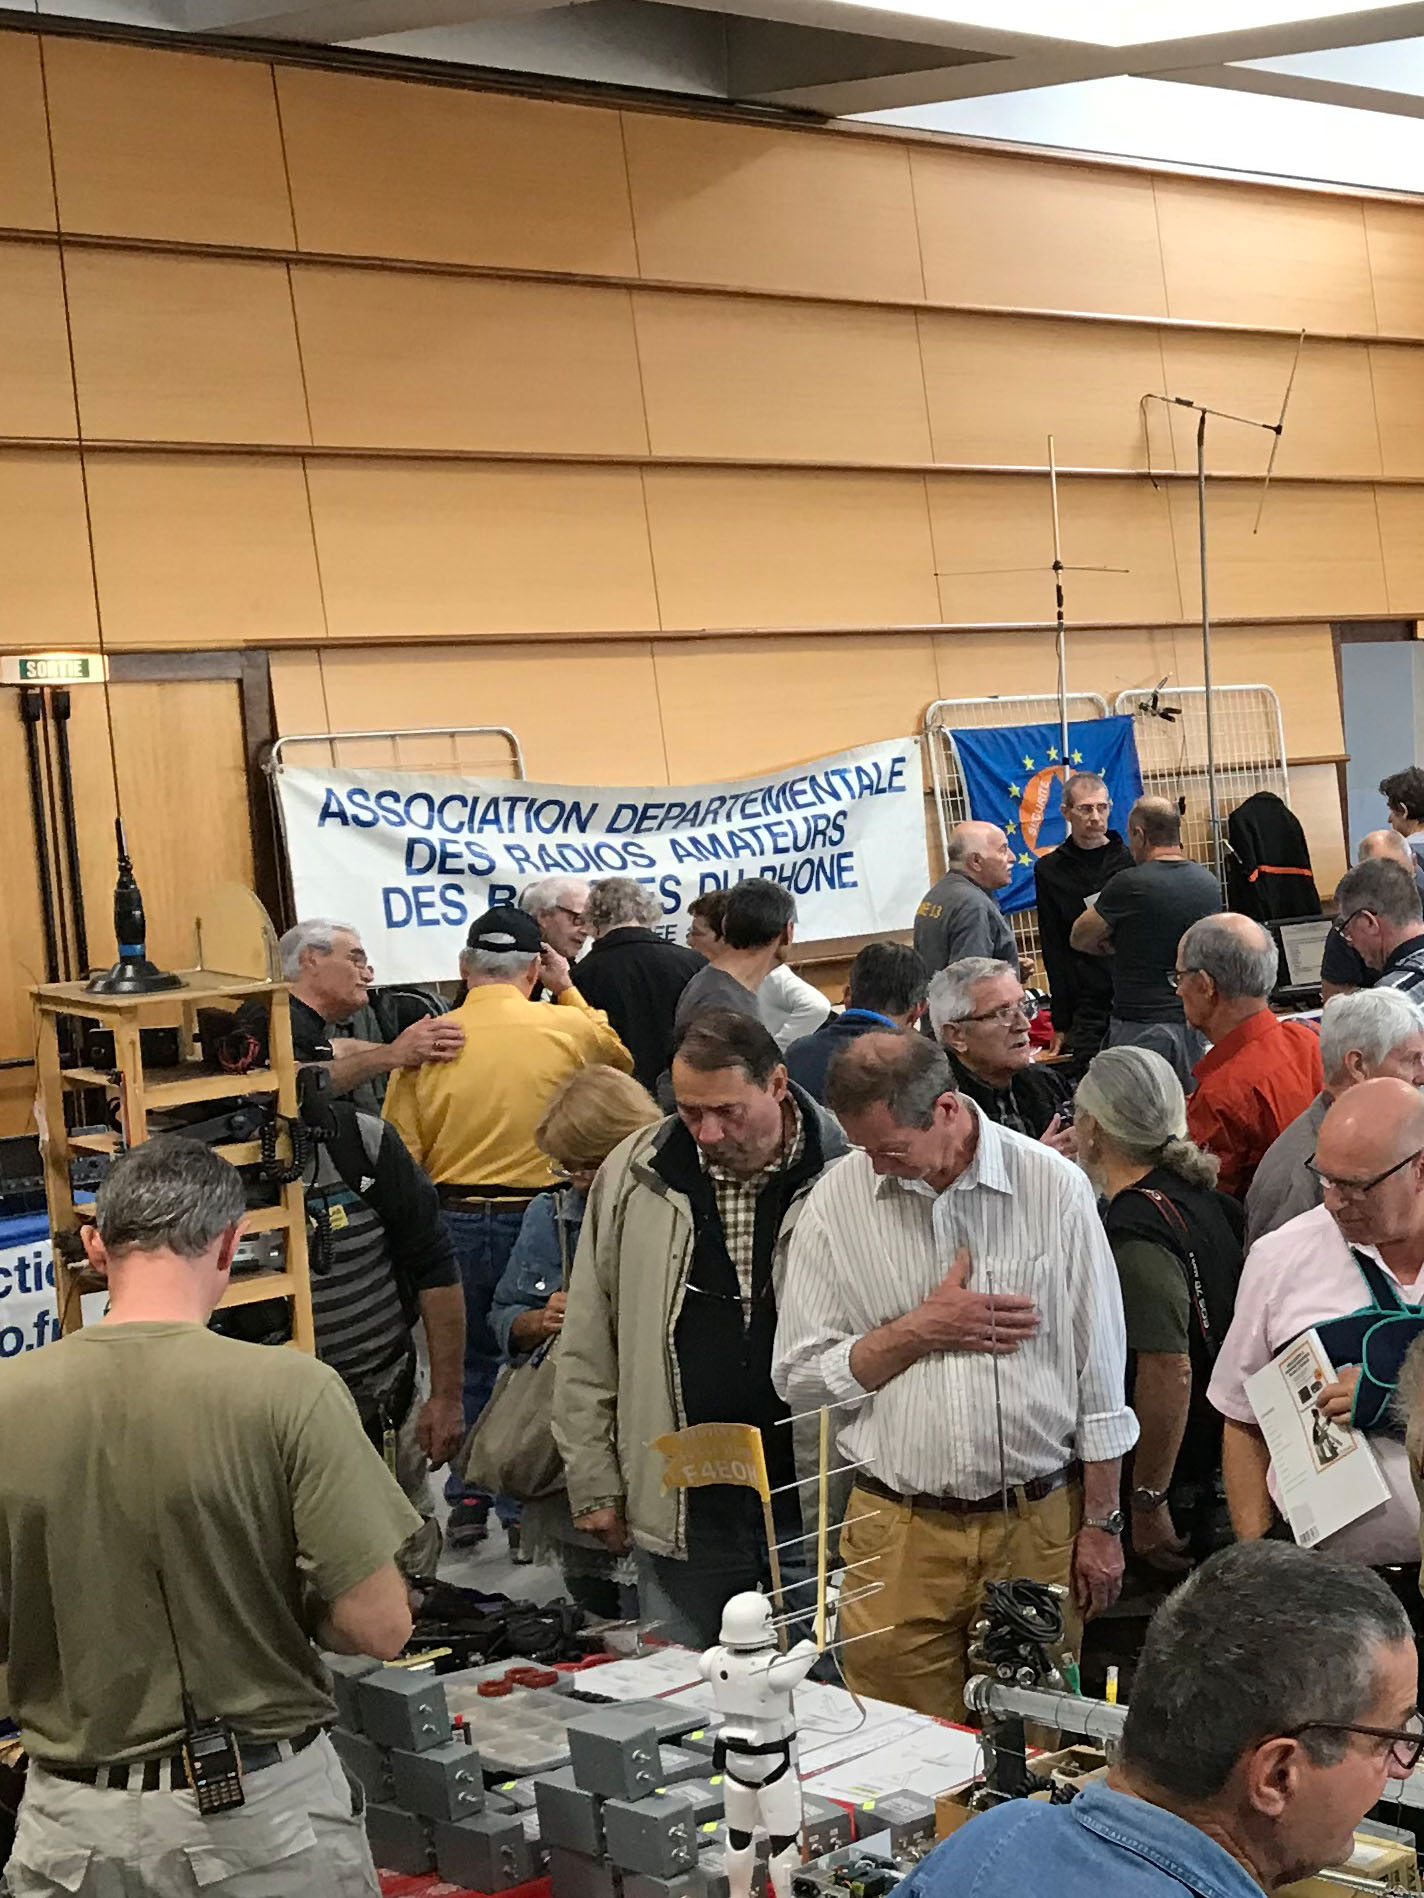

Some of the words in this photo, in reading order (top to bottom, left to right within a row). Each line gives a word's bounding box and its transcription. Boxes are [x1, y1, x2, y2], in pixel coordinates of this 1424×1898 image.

[26, 660, 84, 678] SORTIE
[317, 787, 599, 835] ASSOCIATION
[605, 756, 907, 835] DEPARTEMENTALE
[405, 836, 497, 876] DES
[503, 840, 657, 874] RADIOS
[669, 810, 848, 864] AMATEURS
[382, 882, 468, 929] DES
